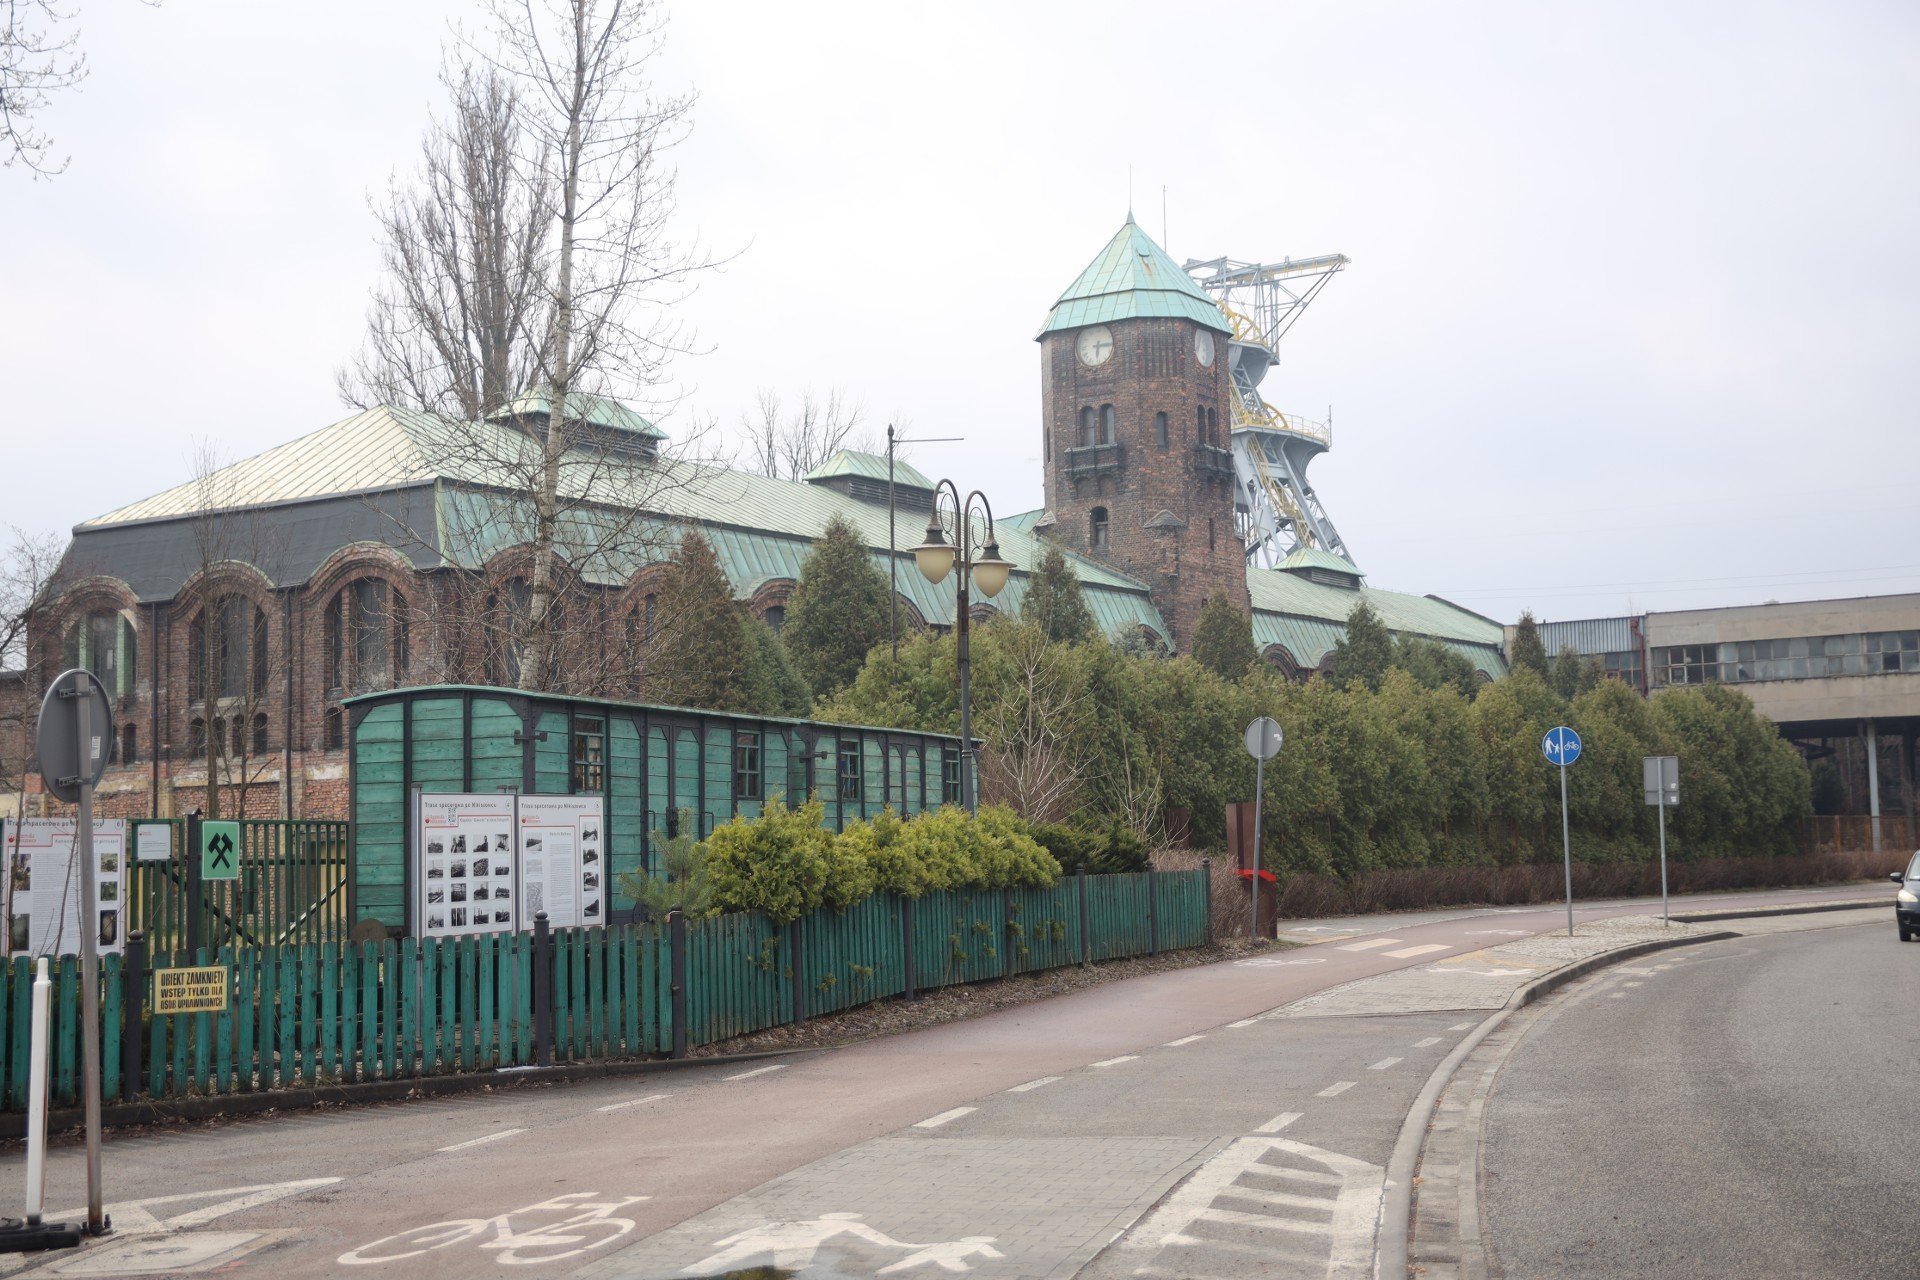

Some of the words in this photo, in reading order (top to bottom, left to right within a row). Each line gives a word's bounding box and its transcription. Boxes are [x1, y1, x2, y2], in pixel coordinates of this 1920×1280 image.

[161, 972, 185, 986] OBIEKT
[188, 986, 209, 997] TYLKO
[212, 986, 223, 995] DLA
[178, 997, 223, 1009] UPRAWNIONYCH
